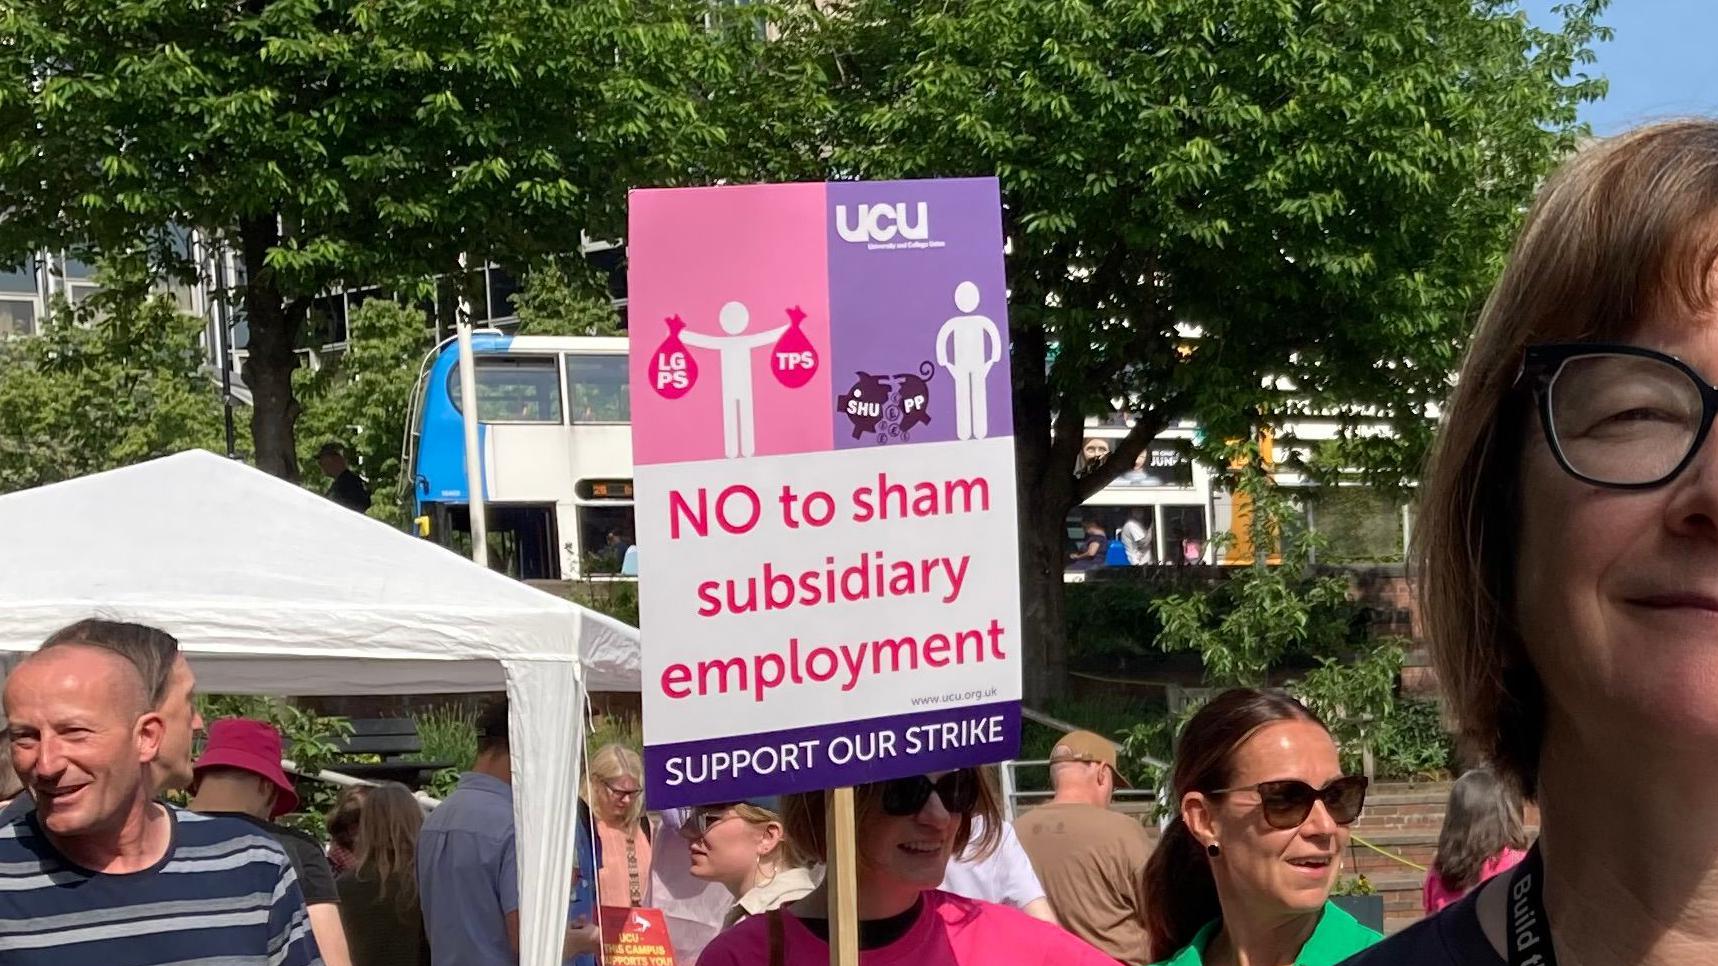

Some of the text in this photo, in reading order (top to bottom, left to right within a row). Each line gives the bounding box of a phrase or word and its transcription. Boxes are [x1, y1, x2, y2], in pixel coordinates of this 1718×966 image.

[658, 352, 686, 371] LG
[776, 350, 815, 370] TPS
[657, 371, 689, 390] PS
[846, 398, 880, 418] SHU
[903, 395, 925, 414] PP
[668, 473, 991, 540] NO to sham
[696, 550, 971, 617] subsidiary
[659, 619, 1006, 702] employment
[910, 687, 998, 706] www.ucu.org.uk
[664, 715, 1004, 787] SUPPORT OUR STRIKE
[1513, 873, 1540, 952] Build
[625, 944, 666, 955] CAMPUS
